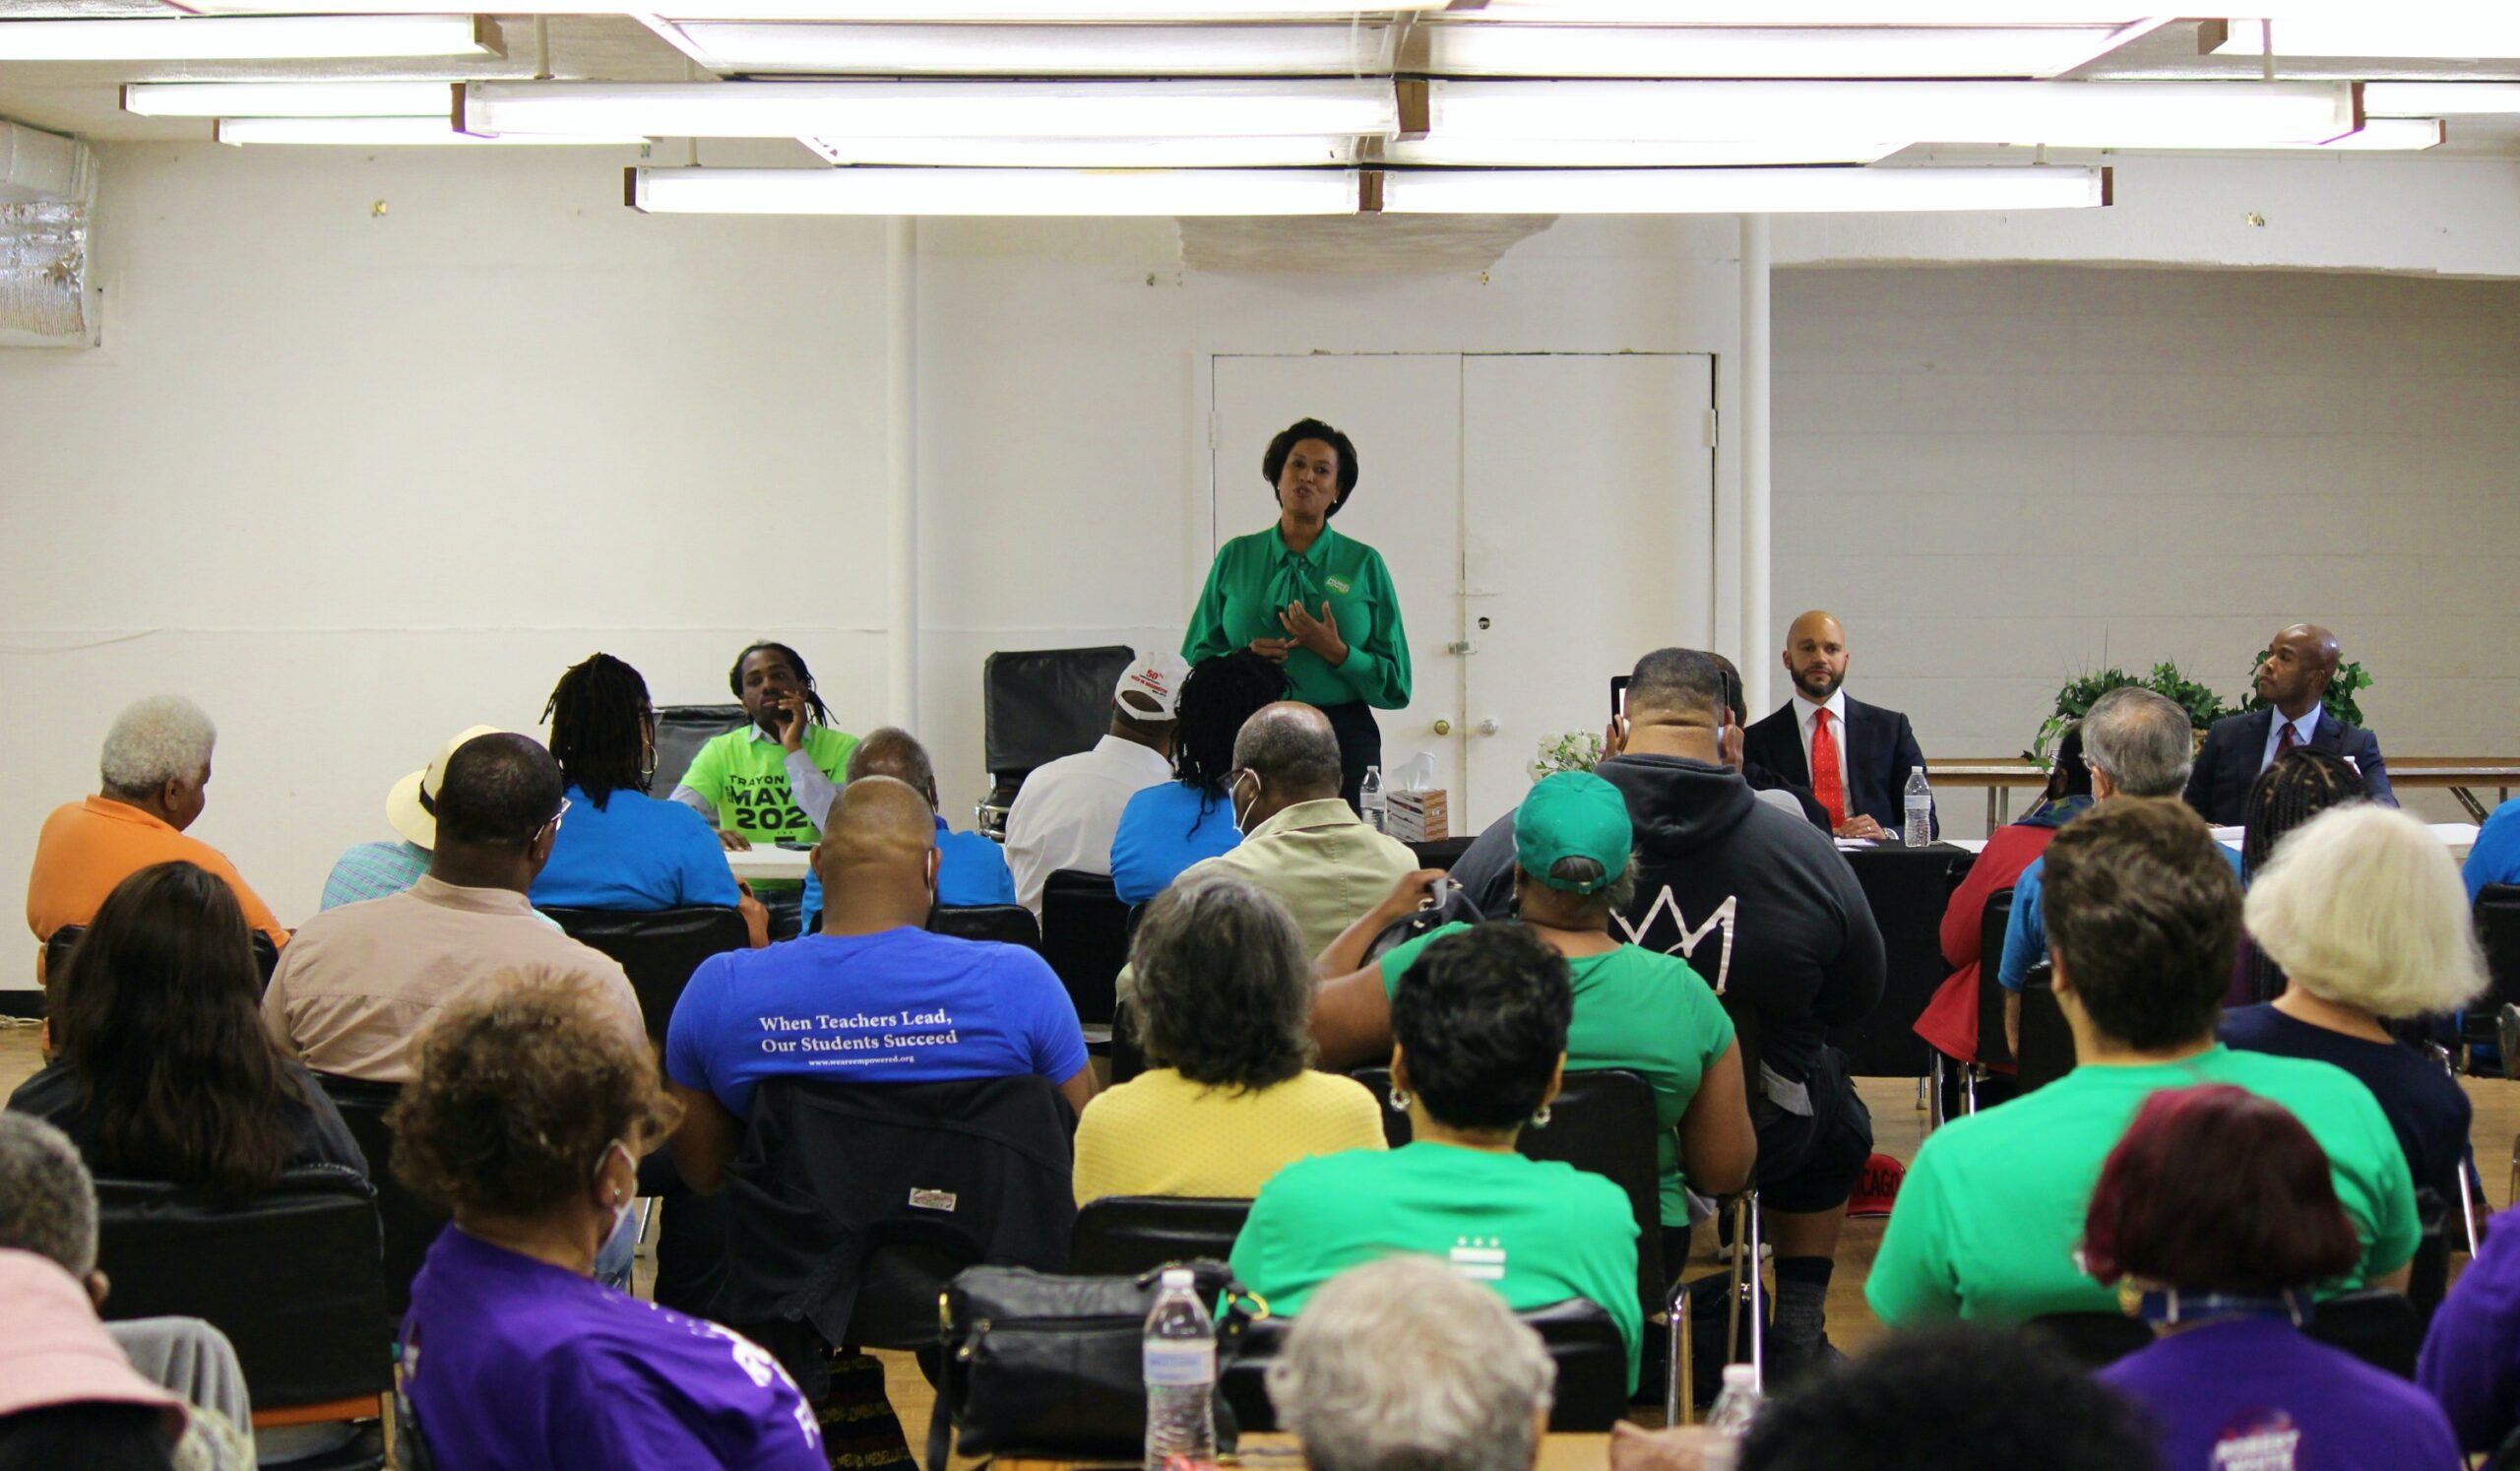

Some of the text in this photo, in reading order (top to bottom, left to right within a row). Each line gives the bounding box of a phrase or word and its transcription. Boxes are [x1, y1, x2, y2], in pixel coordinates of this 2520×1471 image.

[729, 775, 785, 787] TRAYON
[730, 785, 792, 806] MAY
[735, 806, 818, 830] 202
[759, 1008, 952, 1031] When Teachers Lead,
[761, 1029, 958, 1054] Our Students Succeed
[808, 1055, 914, 1067] www.weareempowered.org
